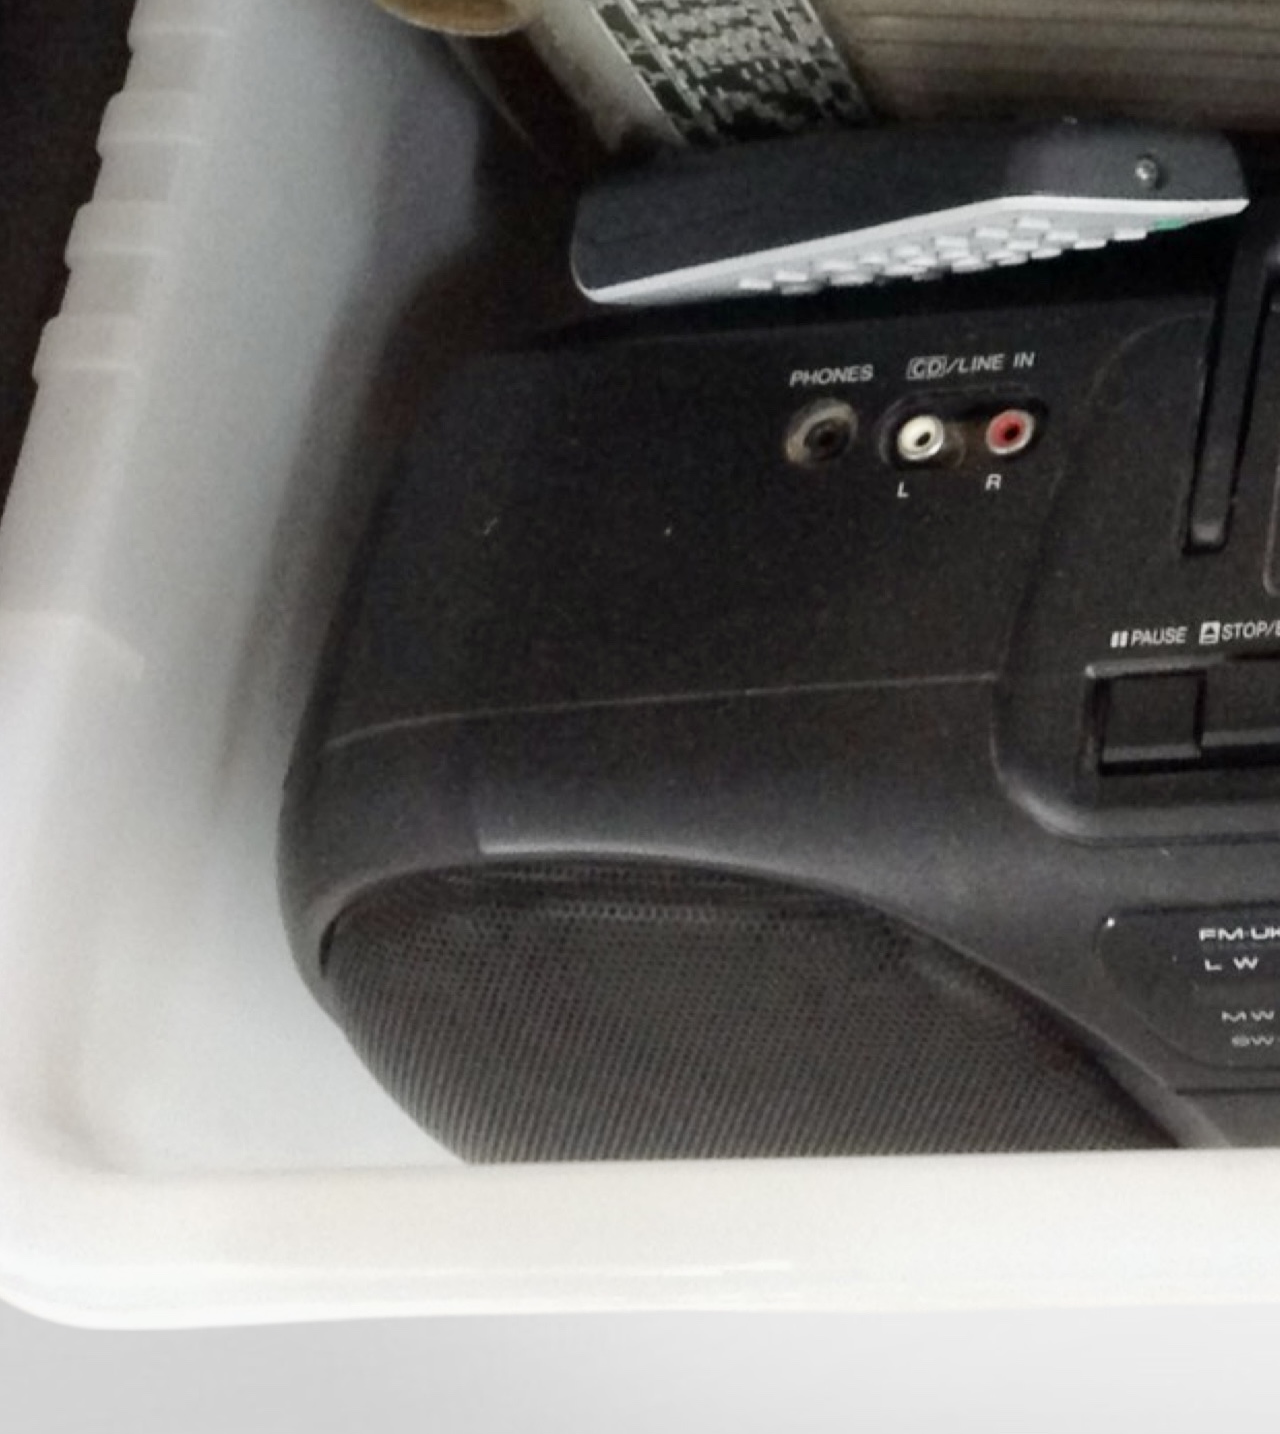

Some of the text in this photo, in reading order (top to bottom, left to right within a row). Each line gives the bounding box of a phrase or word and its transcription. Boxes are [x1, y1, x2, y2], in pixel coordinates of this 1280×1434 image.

[1013, 352, 1035, 368] IN
[790, 364, 874, 387] PHONES
[897, 474, 1001, 497] L R
[1130, 626, 1188, 647] PAUSE
